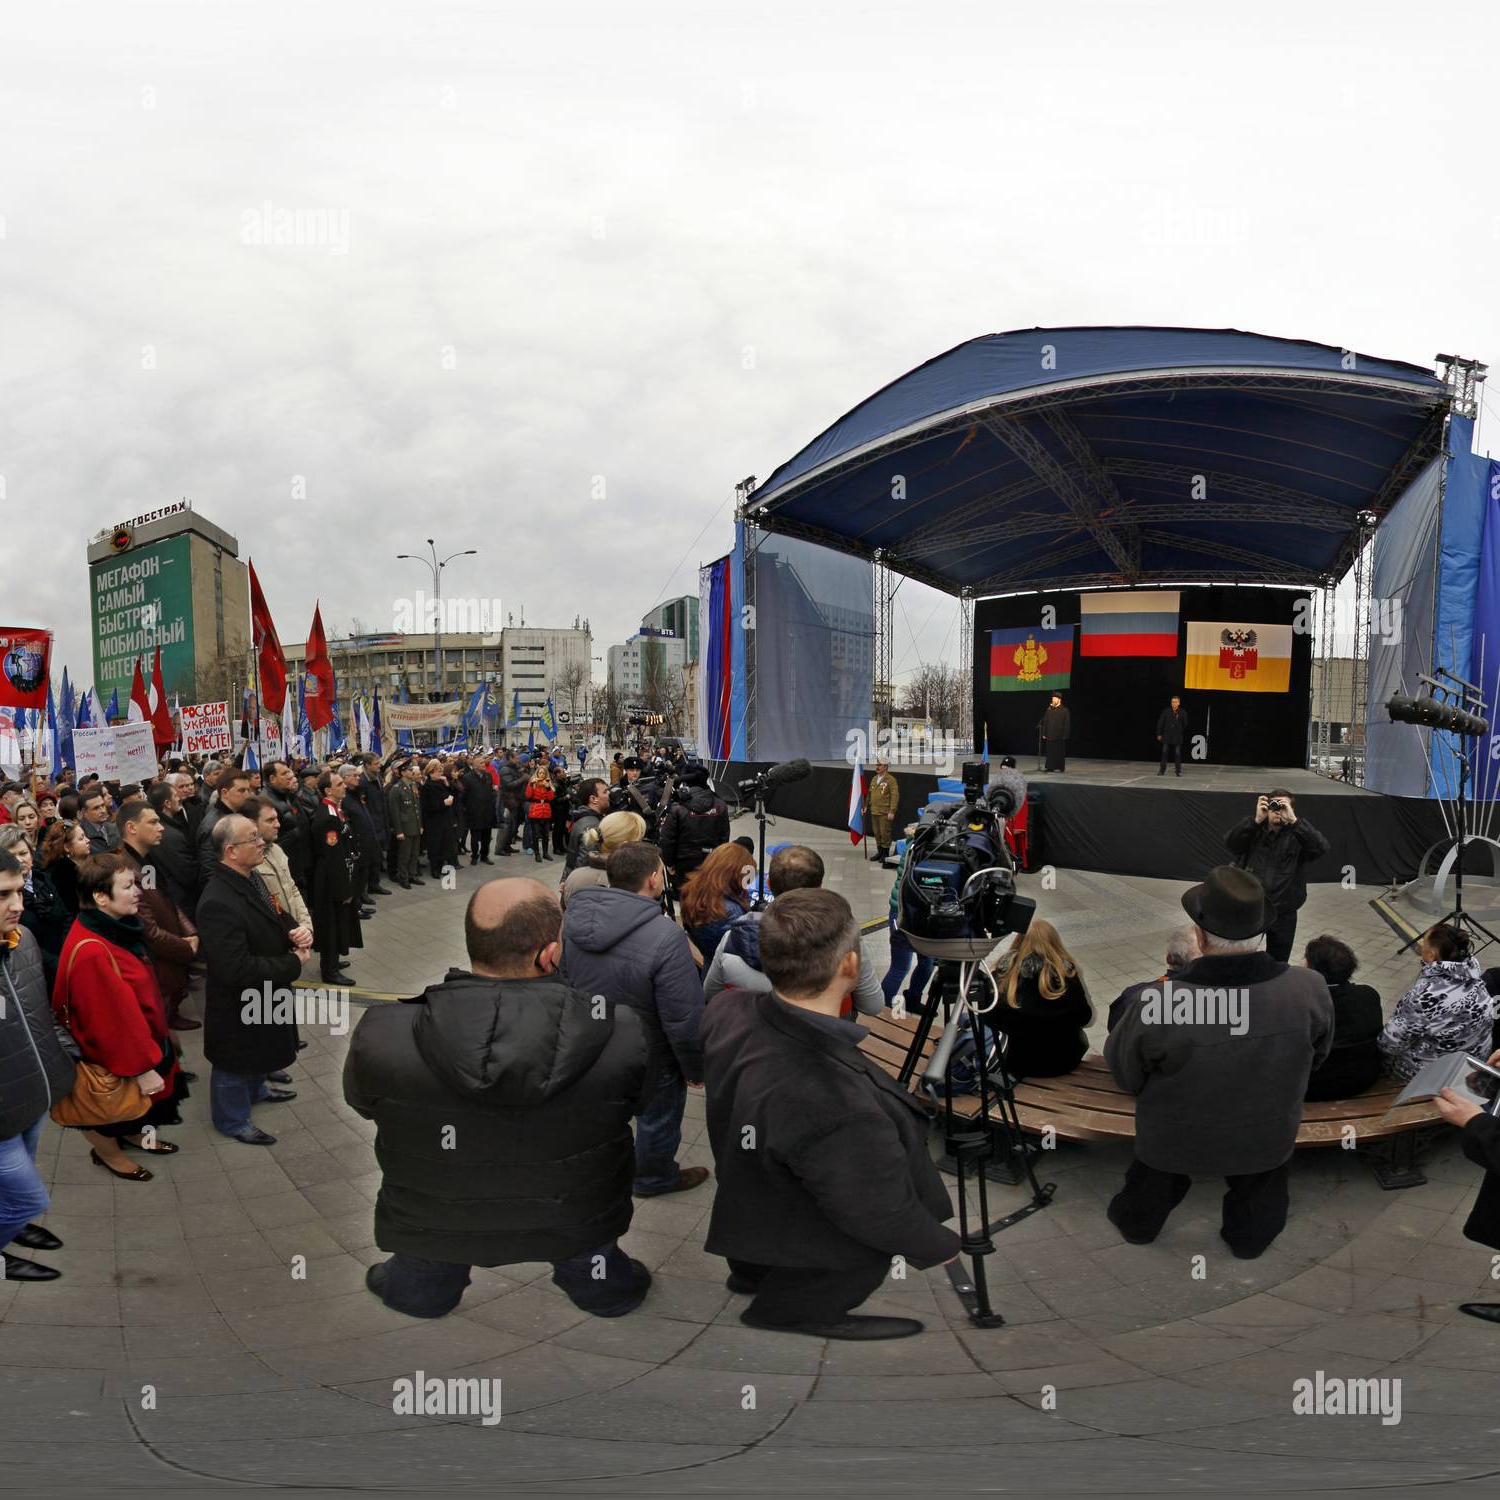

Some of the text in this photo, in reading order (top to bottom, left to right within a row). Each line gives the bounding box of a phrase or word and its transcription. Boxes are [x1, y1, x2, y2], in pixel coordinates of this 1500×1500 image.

[96, 556, 160, 593] МЕГАФОН
[97, 579, 145, 613] САМЫЙ
[100, 617, 185, 658] МОБИЛЬНЫЙ
[181, 703, 225, 719] РОССИЯ
[183, 715, 228, 731] УКРАИНА
[187, 732, 230, 752] ВМЕСТЕ!
